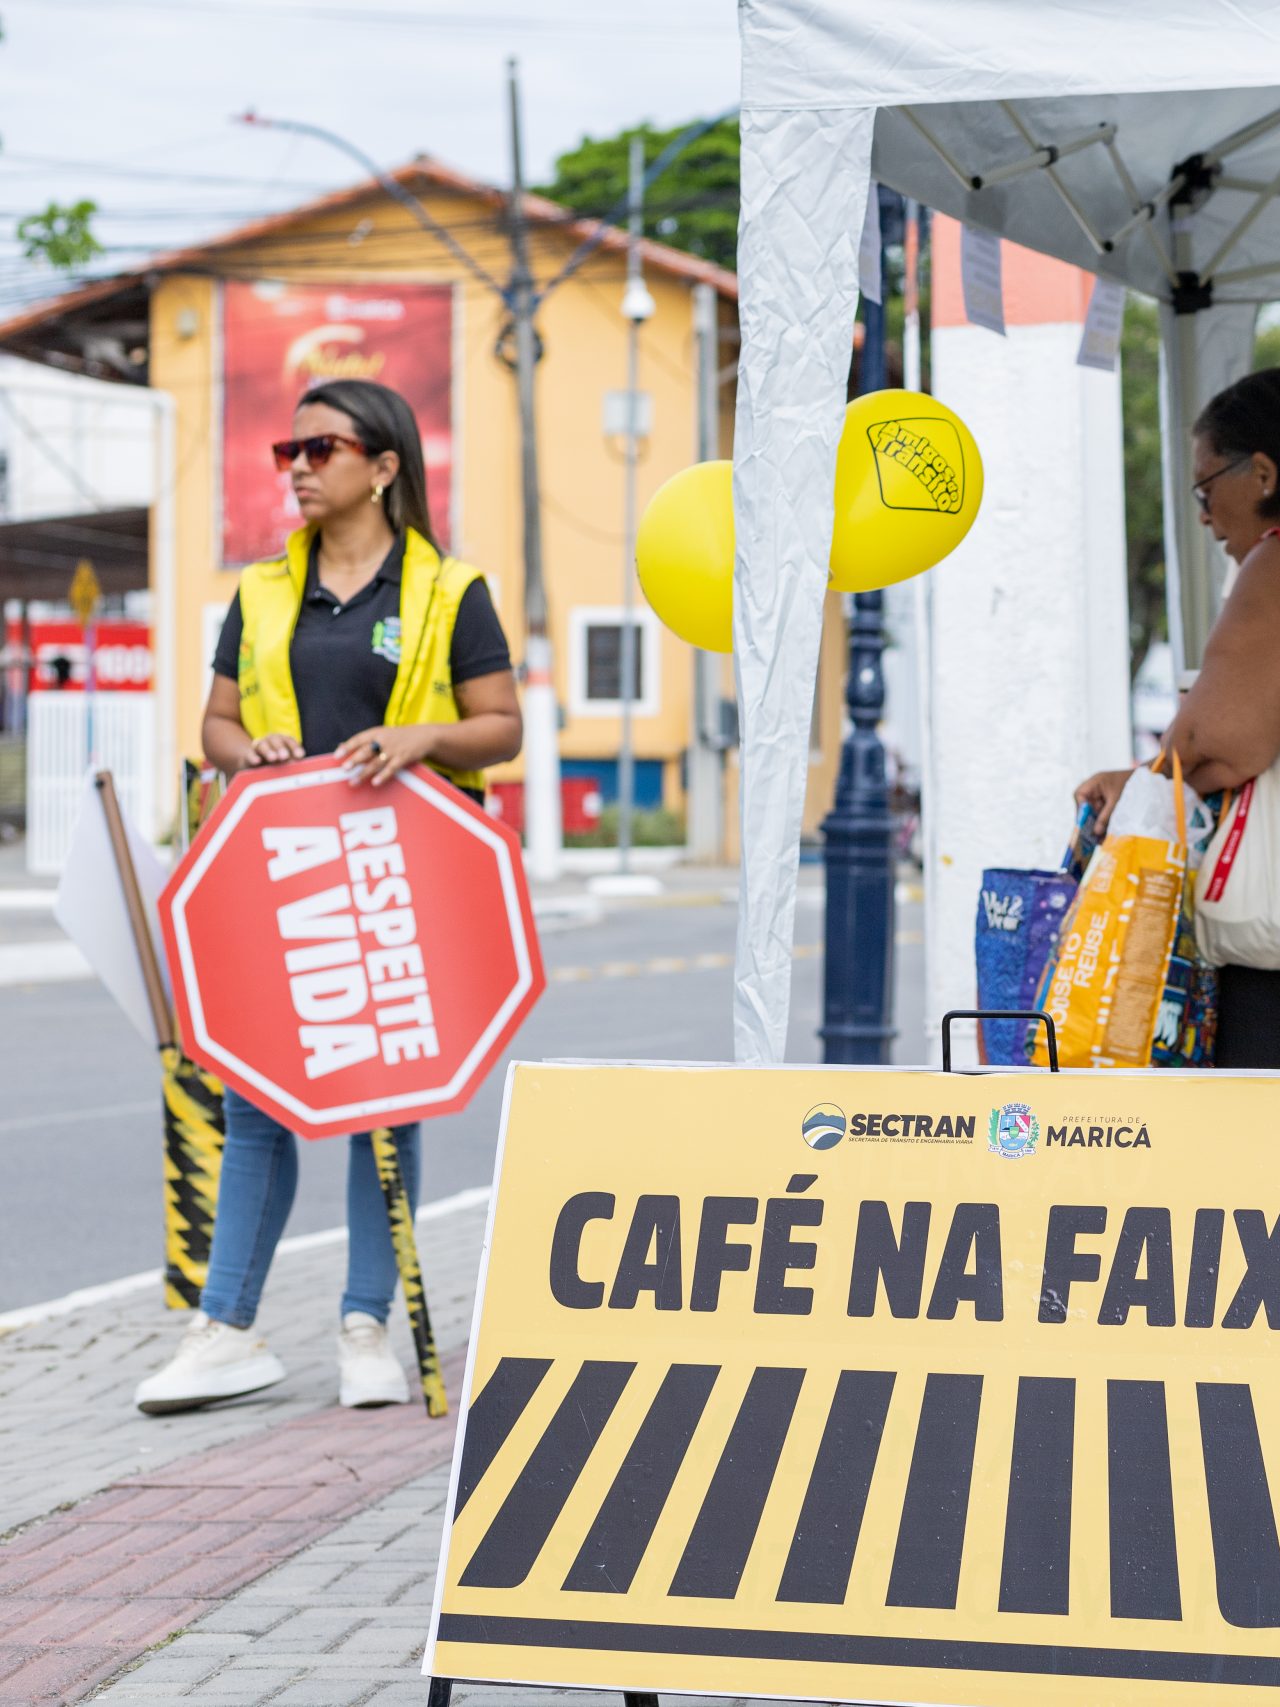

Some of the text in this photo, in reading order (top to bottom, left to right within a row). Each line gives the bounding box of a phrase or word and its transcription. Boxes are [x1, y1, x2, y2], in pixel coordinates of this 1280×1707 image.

[261, 825, 379, 1080] A VIDA
[339, 806, 440, 1065] RESPEITE
[849, 1113, 976, 1138] SECTRAN
[1045, 1122, 1151, 1149] MARICÁ
[1063, 1115, 1141, 1124] PREFEITURA DE
[549, 1174, 824, 1315] CAFÉ
[847, 1200, 1002, 1322] NA
